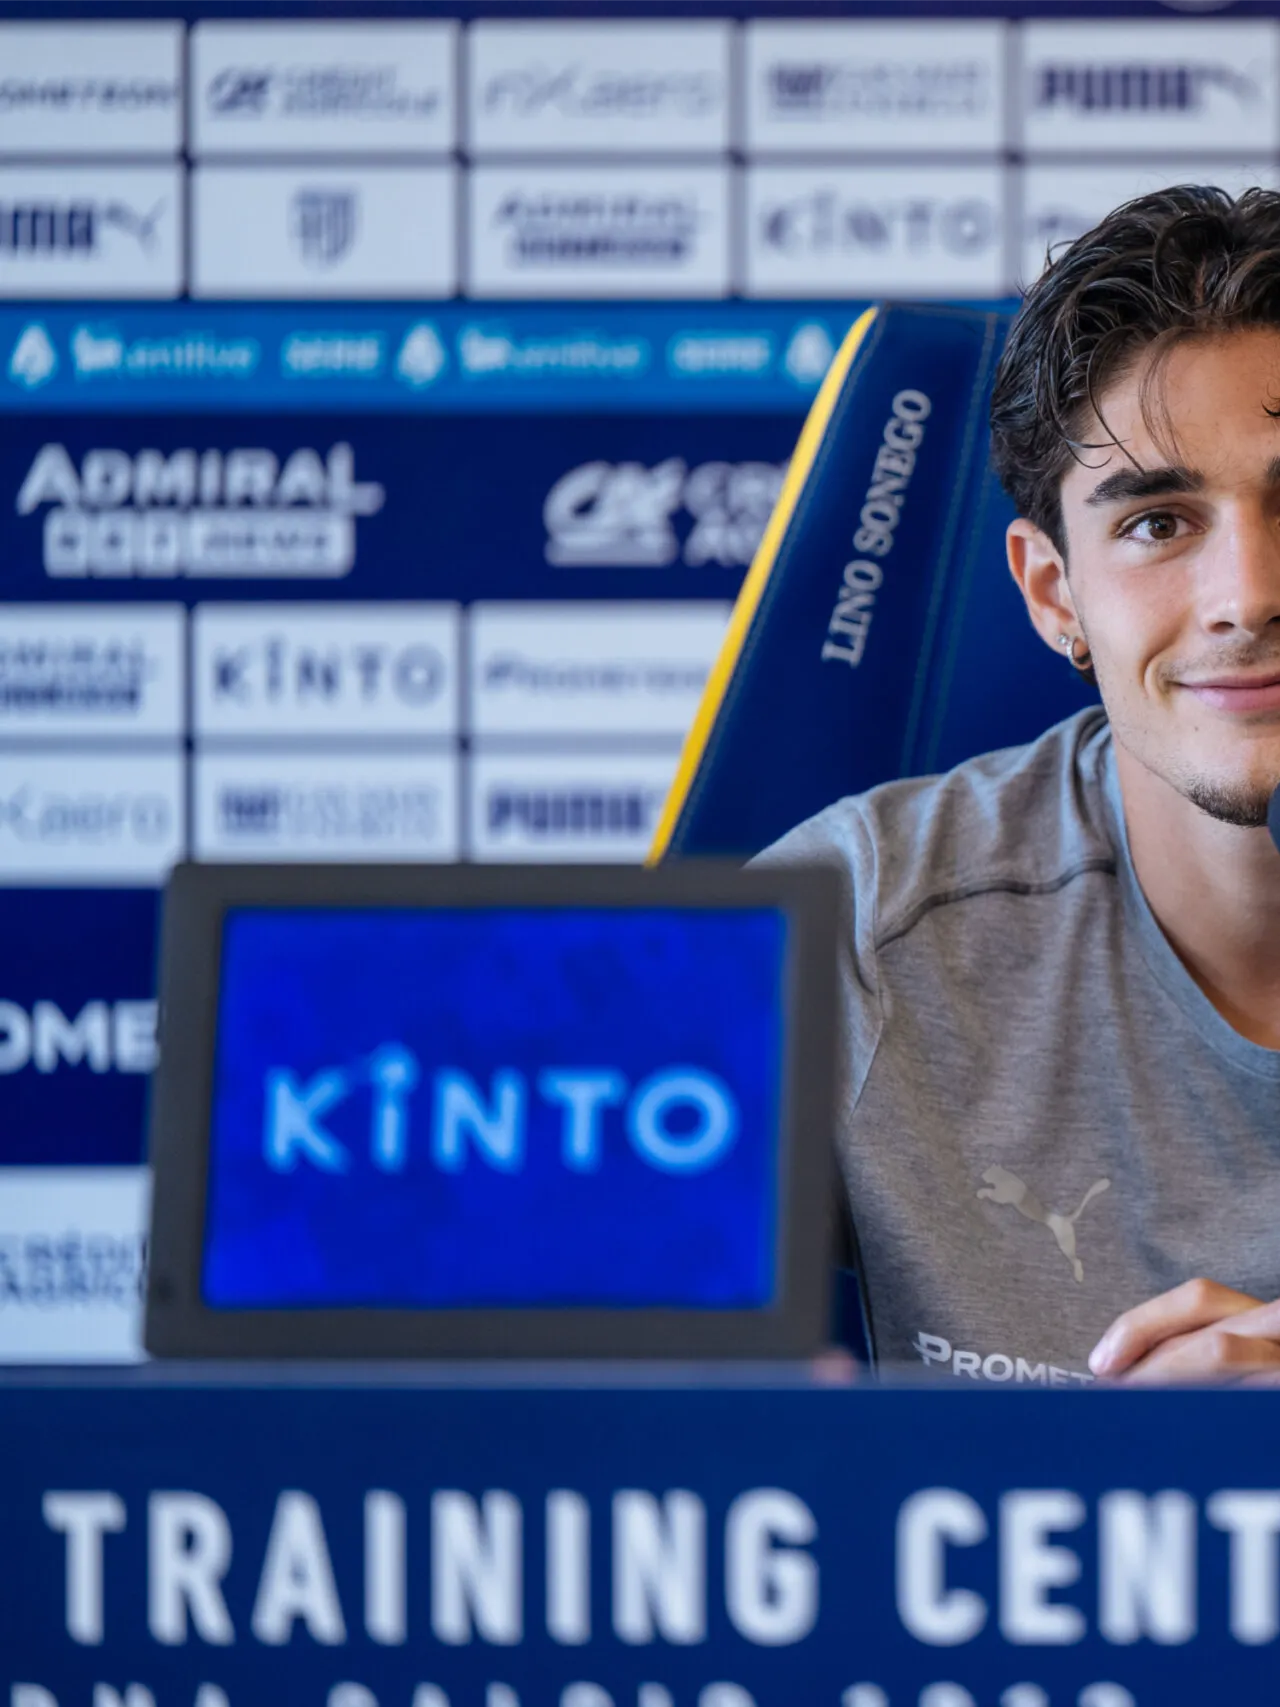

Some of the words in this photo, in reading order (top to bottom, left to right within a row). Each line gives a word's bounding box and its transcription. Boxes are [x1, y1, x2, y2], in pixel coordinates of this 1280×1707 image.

[15, 441, 386, 516] ADMIRAL
[852, 388, 932, 557] SONEGO
[821, 558, 884, 669] LINO
[262, 1042, 738, 1174] KINTO
[42, 1486, 820, 1648] TRAINING
